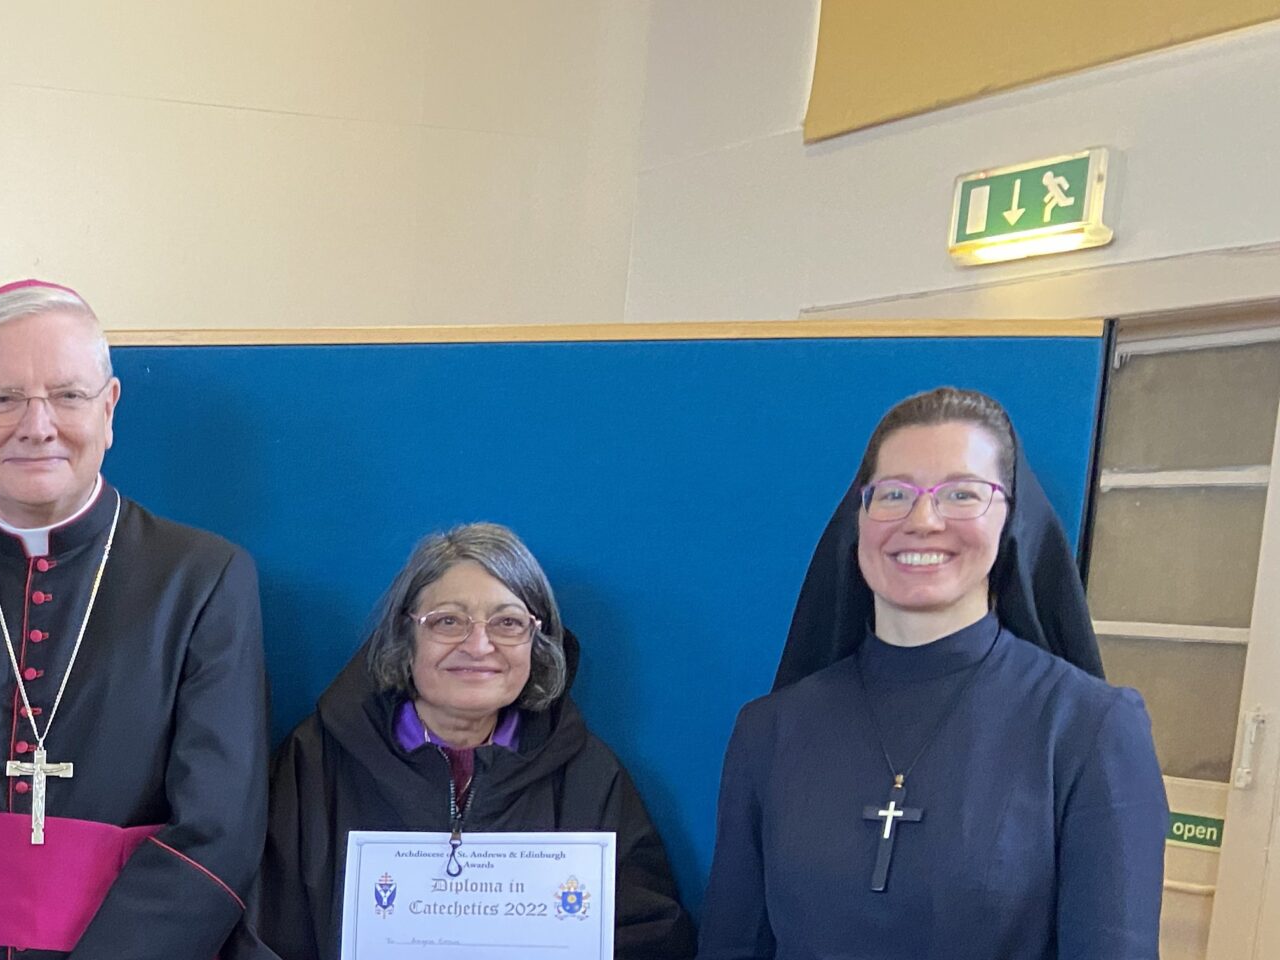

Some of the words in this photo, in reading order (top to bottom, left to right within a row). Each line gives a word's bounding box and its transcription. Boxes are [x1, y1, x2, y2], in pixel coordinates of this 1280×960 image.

[1172, 821, 1218, 841] open
[395, 850, 444, 858] Archdiocese
[520, 851, 566, 860] Edinburgh
[464, 861, 494, 869] Awards
[431, 878, 503, 894] Diploma
[510, 880, 525, 892] in
[409, 900, 499, 918] Catechetics
[504, 902, 548, 917] 2022
